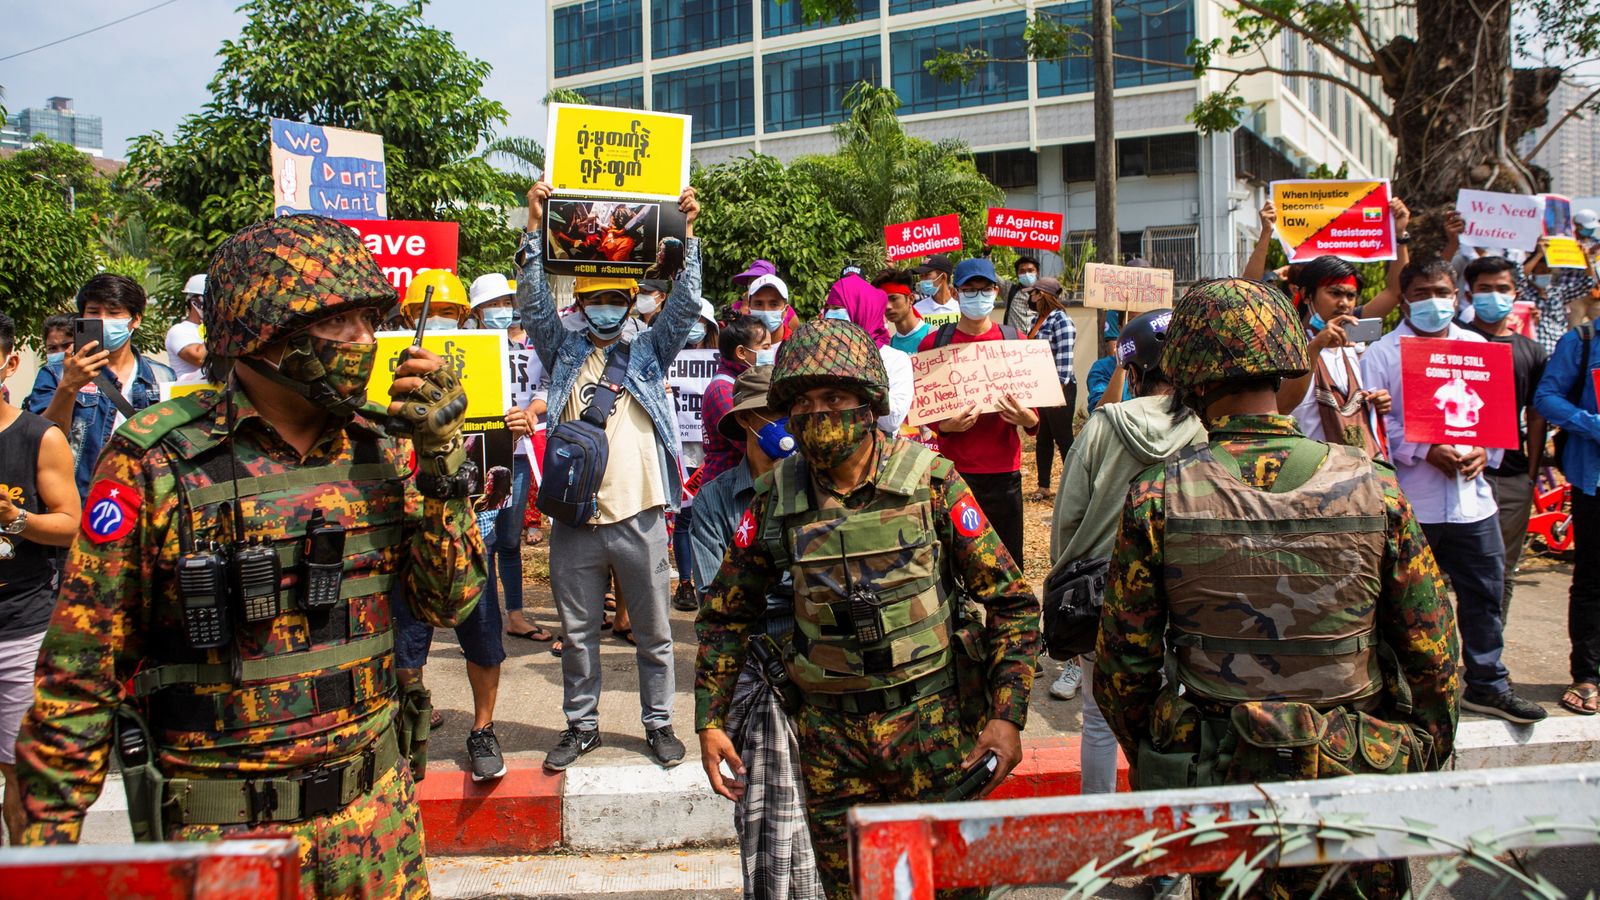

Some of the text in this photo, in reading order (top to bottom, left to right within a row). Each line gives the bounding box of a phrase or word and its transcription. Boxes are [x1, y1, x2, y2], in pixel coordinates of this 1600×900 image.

[284, 129, 322, 152] We
[319, 190, 374, 212] Want
[1282, 189, 1349, 201] When Injustice
[1282, 202, 1324, 211] becomes
[1471, 200, 1537, 218] We Need
[1006, 216, 1054, 230] Against
[1283, 216, 1309, 228] law,
[913, 223, 941, 238] Civil
[988, 226, 1059, 245] Military Coup
[1330, 227, 1383, 237] Resistance
[1464, 221, 1517, 240] Justice
[889, 236, 960, 257] Disobedience
[1317, 239, 1384, 250] becomes duty.
[575, 264, 643, 275] #CDM #SaveLives
[1104, 285, 1168, 304] PROTEST
[1149, 314, 1173, 330] PRE
[911, 350, 947, 375] Reject
[949, 347, 970, 364] The
[1429, 354, 1485, 367] ARE YOU STILL
[1426, 367, 1490, 381] GOING TO WORK?
[934, 386, 958, 405] Need
[983, 394, 993, 404] of
